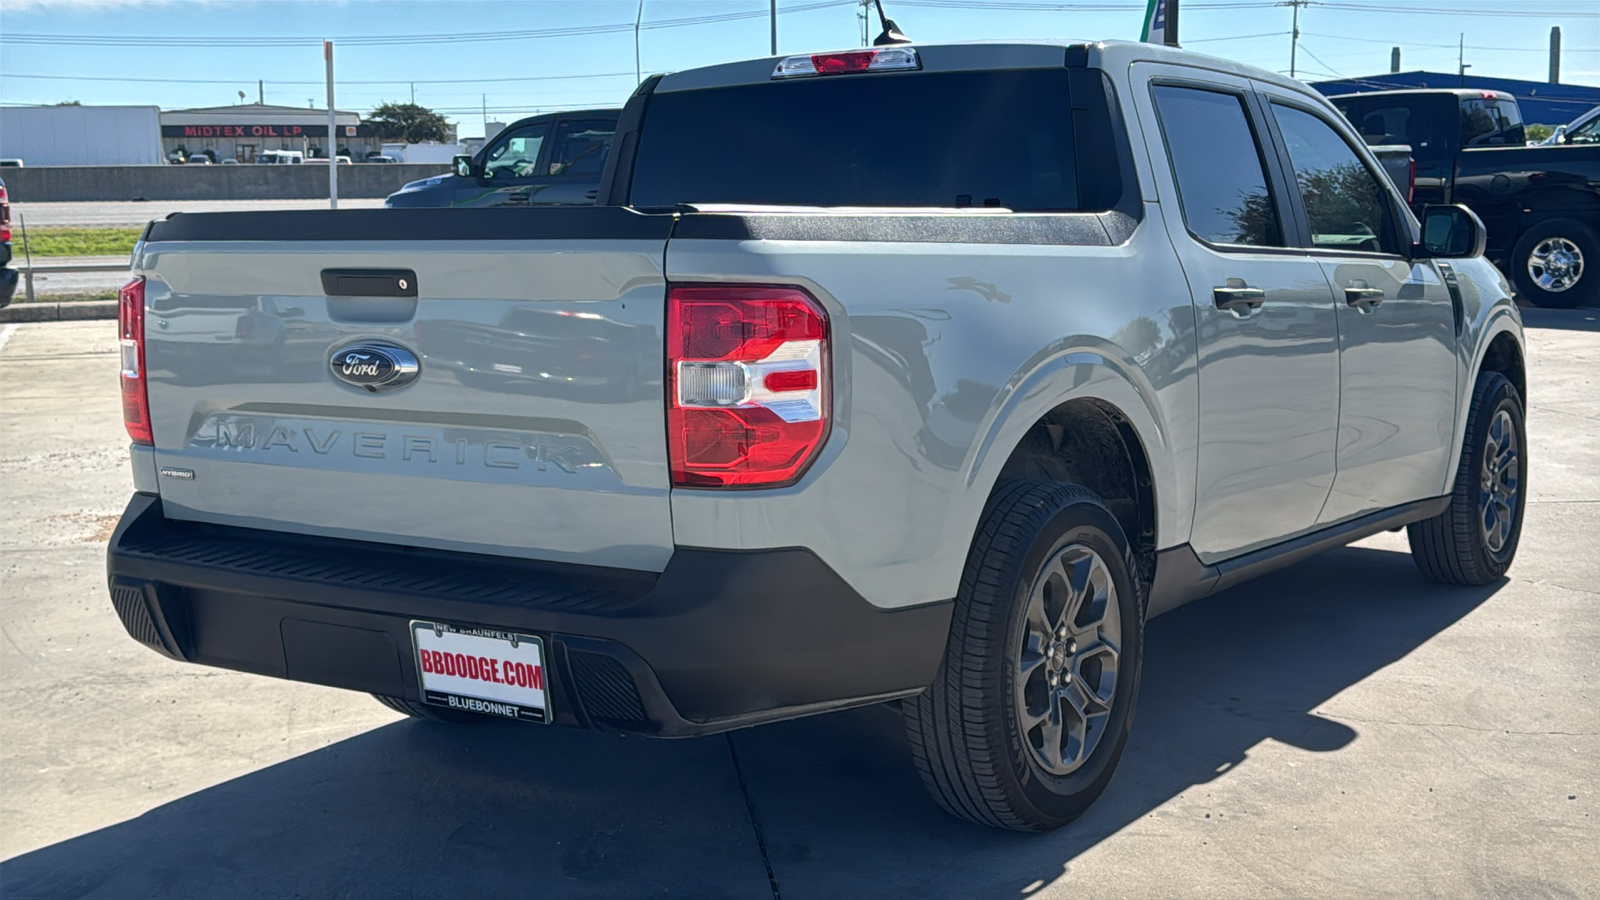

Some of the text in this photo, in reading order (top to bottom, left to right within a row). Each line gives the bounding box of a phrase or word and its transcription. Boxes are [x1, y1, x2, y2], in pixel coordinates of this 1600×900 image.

[185, 125, 303, 137] MIDTEX OIL LP
[342, 353, 380, 376] Ford
[214, 420, 580, 474] MAVERICK
[162, 469, 191, 478] HYBRID
[436, 623, 457, 633] NEW
[420, 649, 544, 690] BBDODGE.COM
[448, 696, 519, 718] BLUEBONNET
